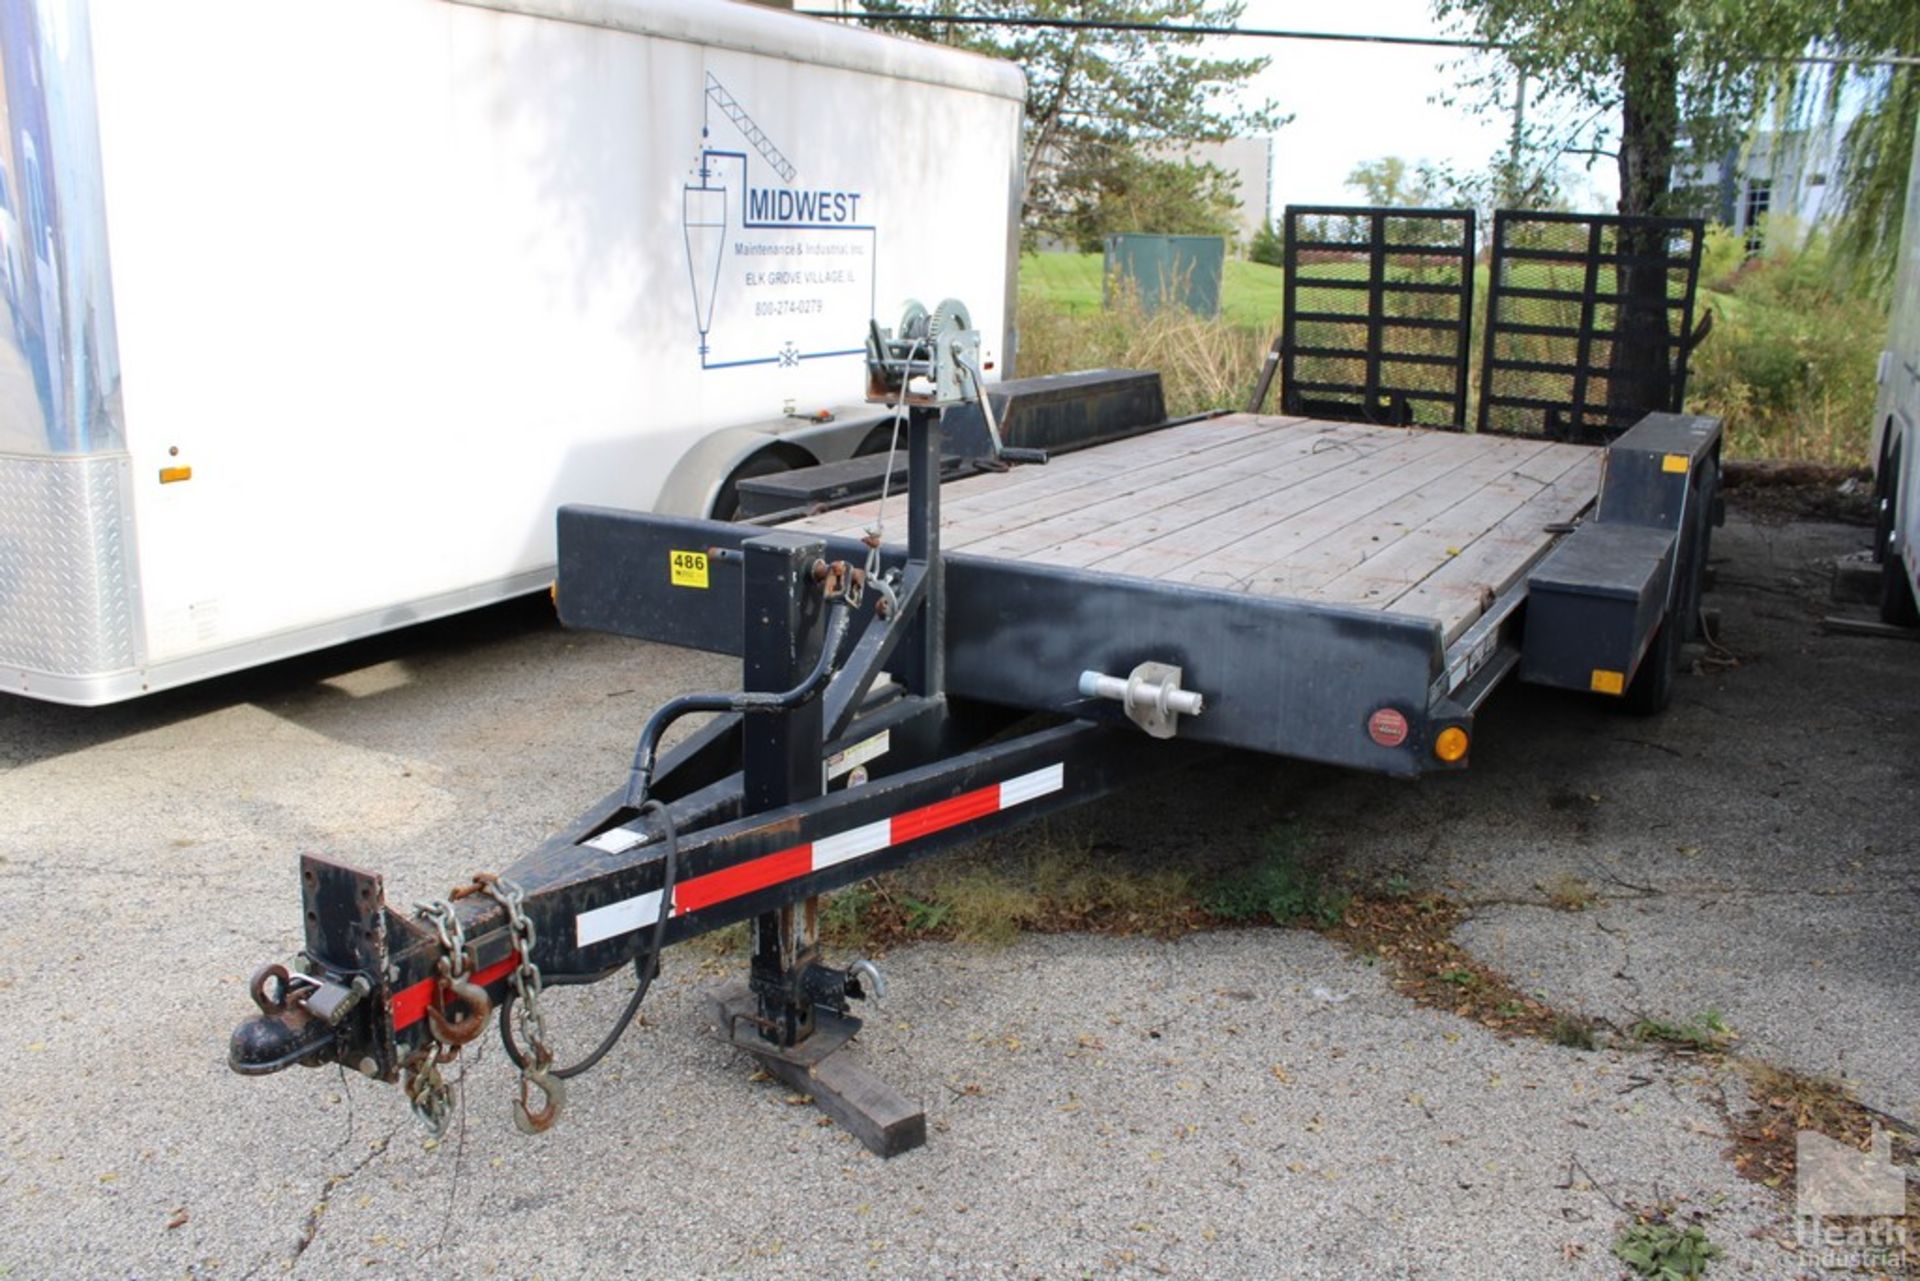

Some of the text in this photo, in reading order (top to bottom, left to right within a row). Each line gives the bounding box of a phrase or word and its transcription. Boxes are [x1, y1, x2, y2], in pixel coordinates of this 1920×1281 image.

[749, 187, 861, 222] MIDWEST
[745, 271, 766, 286] ELK
[768, 271, 801, 286] GROVE
[755, 299, 823, 317] 800-274-0279
[674, 554, 704, 571] 486
